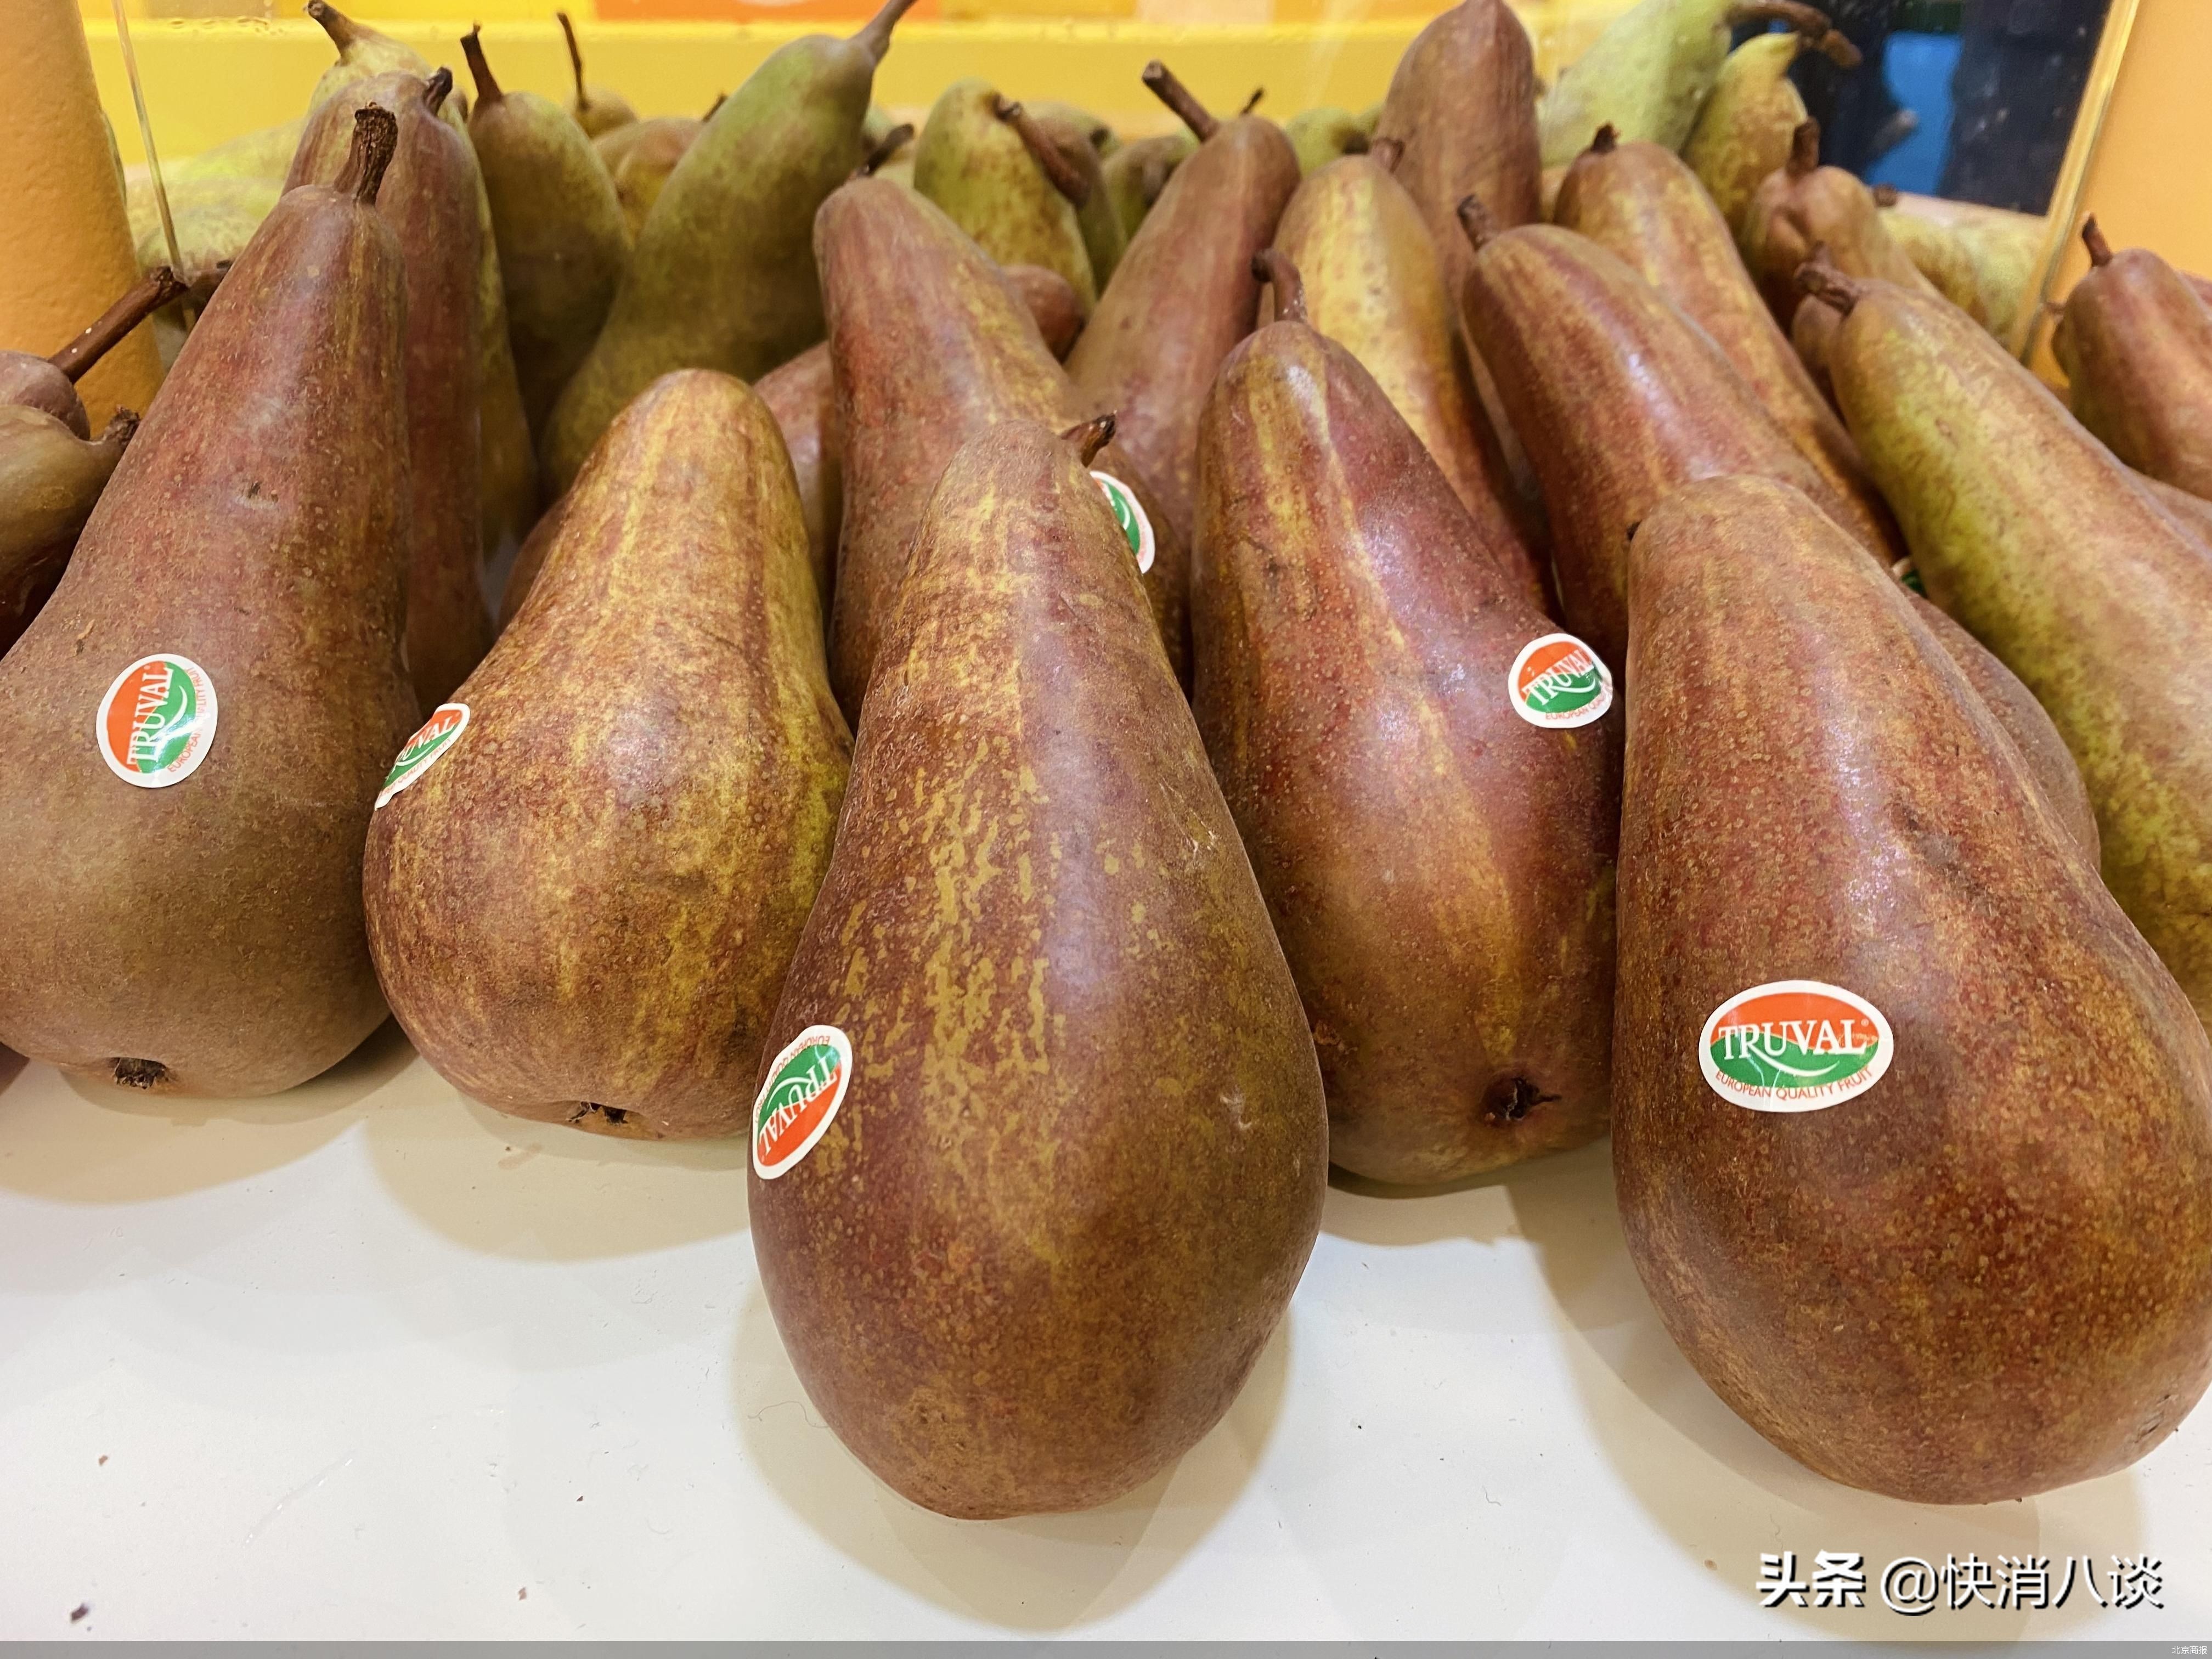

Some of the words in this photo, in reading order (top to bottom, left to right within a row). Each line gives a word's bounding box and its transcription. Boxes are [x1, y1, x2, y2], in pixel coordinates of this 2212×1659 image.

[1521, 649, 1594, 706] TRUVAL
[127, 667, 174, 765] TRUVAL
[1718, 1019, 1867, 1060] TRUVAL
[759, 1056, 838, 1154] TRUVAL
[1716, 1070, 1771, 1098] EUROPEAN
[1776, 1084, 1834, 1101] QUALITY
[1838, 1066, 1873, 1092] FRUIT
